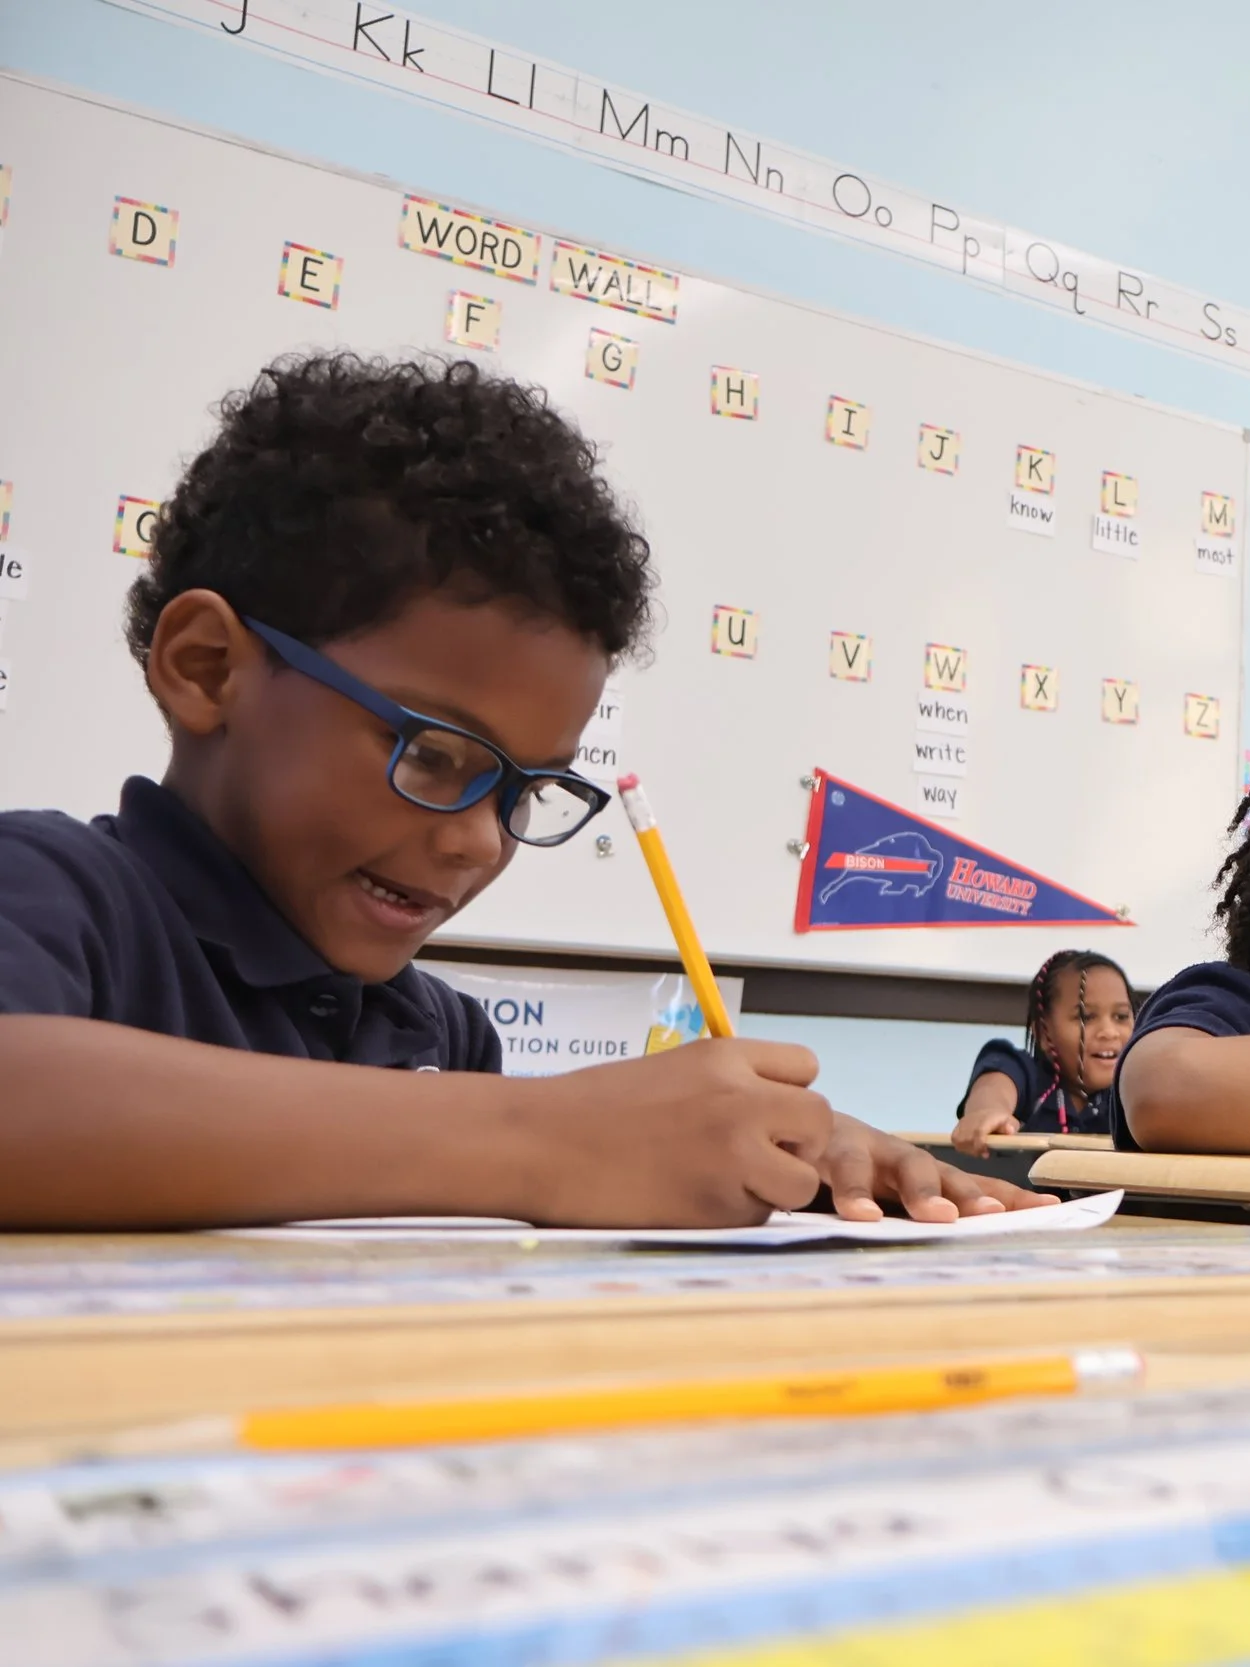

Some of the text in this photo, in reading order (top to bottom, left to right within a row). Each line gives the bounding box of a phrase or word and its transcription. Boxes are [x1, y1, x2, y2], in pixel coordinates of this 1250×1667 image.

[353, 2, 424, 73] Kk
[487, 49, 536, 109] Ll
[600, 88, 689, 161] Mm
[724, 131, 784, 193] Nn
[832, 173, 893, 227] Oo
[930, 203, 980, 275] Pp
[1025, 241, 1086, 315] Qq
[1116, 270, 1159, 319] Rr
[1200, 302, 1237, 348] Ss
[131, 210, 157, 246] D
[300, 256, 321, 292] E
[416, 210, 662, 311] WORD WALL
[465, 302, 486, 333] F
[601, 342, 623, 372] G
[725, 377, 745, 407] H
[842, 408, 857, 437] I
[929, 434, 949, 462] J
[1027, 455, 1044, 482] K
[1113, 481, 1127, 507] L
[1009, 495, 1054, 525] know
[1208, 504, 1229, 528] M
[1094, 515, 1139, 548] little
[1196, 544, 1236, 568] most
[727, 616, 746, 647] U
[842, 642, 861, 670] V
[932, 654, 961, 682] W
[1033, 673, 1049, 702] X
[1114, 686, 1128, 714] Y
[918, 699, 968, 727] when
[1195, 702, 1211, 728] Z
[915, 741, 966, 765] write
[923, 786, 957, 810] way
[844, 854, 886, 870] BISON
[948, 855, 1038, 901] HOWARD
[945, 883, 1033, 917] UNIVERSITY
[477, 999, 544, 1026] ION
[568, 1040, 629, 1056] GUIDE
